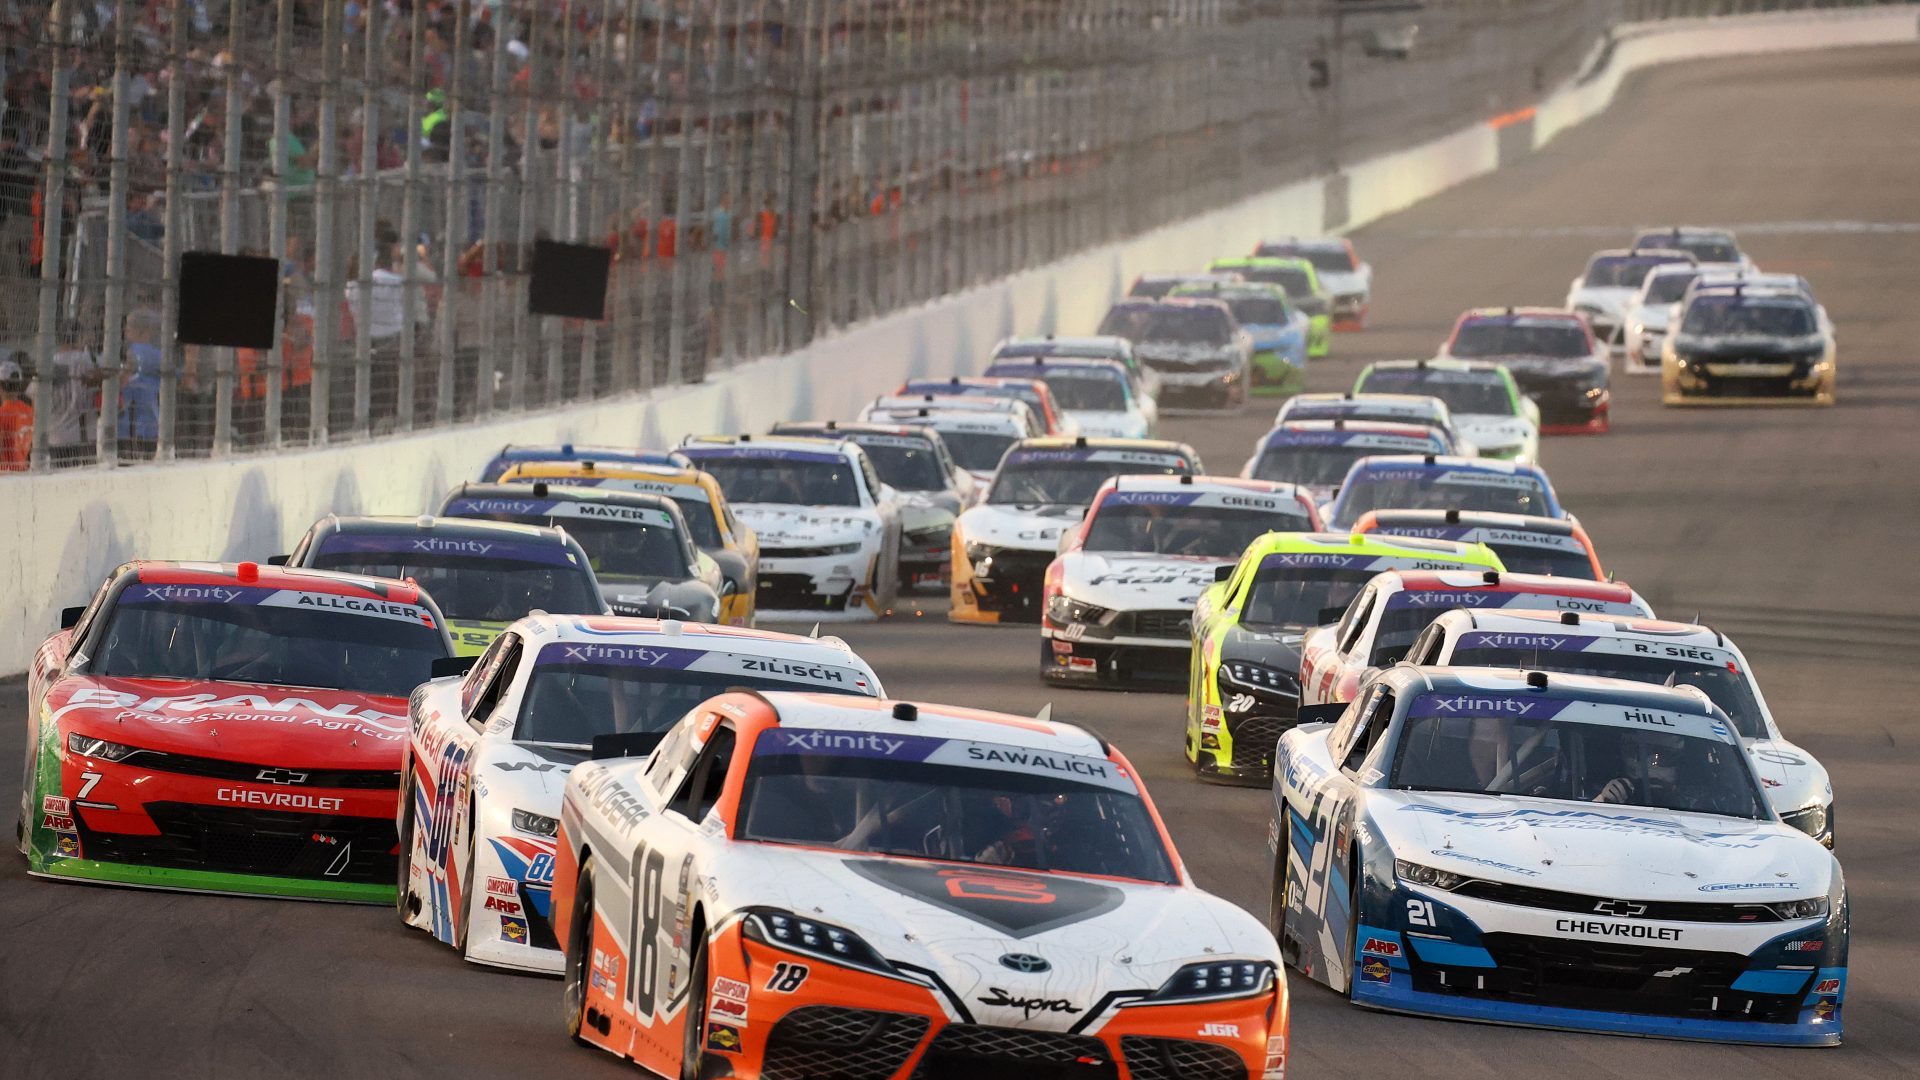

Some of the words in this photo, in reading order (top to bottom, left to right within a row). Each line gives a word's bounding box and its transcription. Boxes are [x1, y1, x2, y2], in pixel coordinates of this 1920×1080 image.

[466, 500, 535, 513] xfinity
[1119, 493, 1181, 505] xfinity
[1222, 496, 1276, 509] CREED
[580, 506, 644, 521] MAYER
[413, 536, 492, 555] xfinity
[1489, 531, 1563, 545] SANCHEZ
[1279, 552, 1354, 567] xfinity
[145, 583, 242, 603] xfinity
[1407, 591, 1488, 606] xfinity
[298, 594, 418, 620] ALLGAIER
[1556, 601, 1605, 613] LOVE
[1478, 633, 1567, 650] xfinity
[564, 643, 668, 665] xfinity
[1635, 644, 1657, 653] R.
[1666, 647, 1714, 661] SIEG
[741, 659, 843, 683] ZILISCH
[67, 688, 412, 733] BRAND
[1228, 693, 1256, 713] 20
[1435, 695, 1536, 715] xfinity
[115, 711, 298, 724] Professional
[302, 718, 404, 741] Agricul
[1624, 711, 1676, 727] HILL
[787, 731, 904, 755] xfinity
[968, 747, 1107, 778] SAWALICH
[76, 771, 103, 799] 7
[217, 788, 344, 811] CHEVROLET
[43, 815, 74, 829] ARP
[487, 880, 514, 895] SIMPSON
[1710, 882, 1798, 891] BENNETT
[485, 896, 521, 913] ARP
[1406, 899, 1437, 927] 21
[502, 925, 526, 936] SUNOCO
[626, 839, 665, 1018] 18
[1556, 919, 1684, 942] CHEVROLET
[1363, 939, 1399, 955] ARP
[764, 960, 810, 994] 18
[977, 987, 1082, 1020] Supra
[1197, 1023, 1239, 1038] JGR
